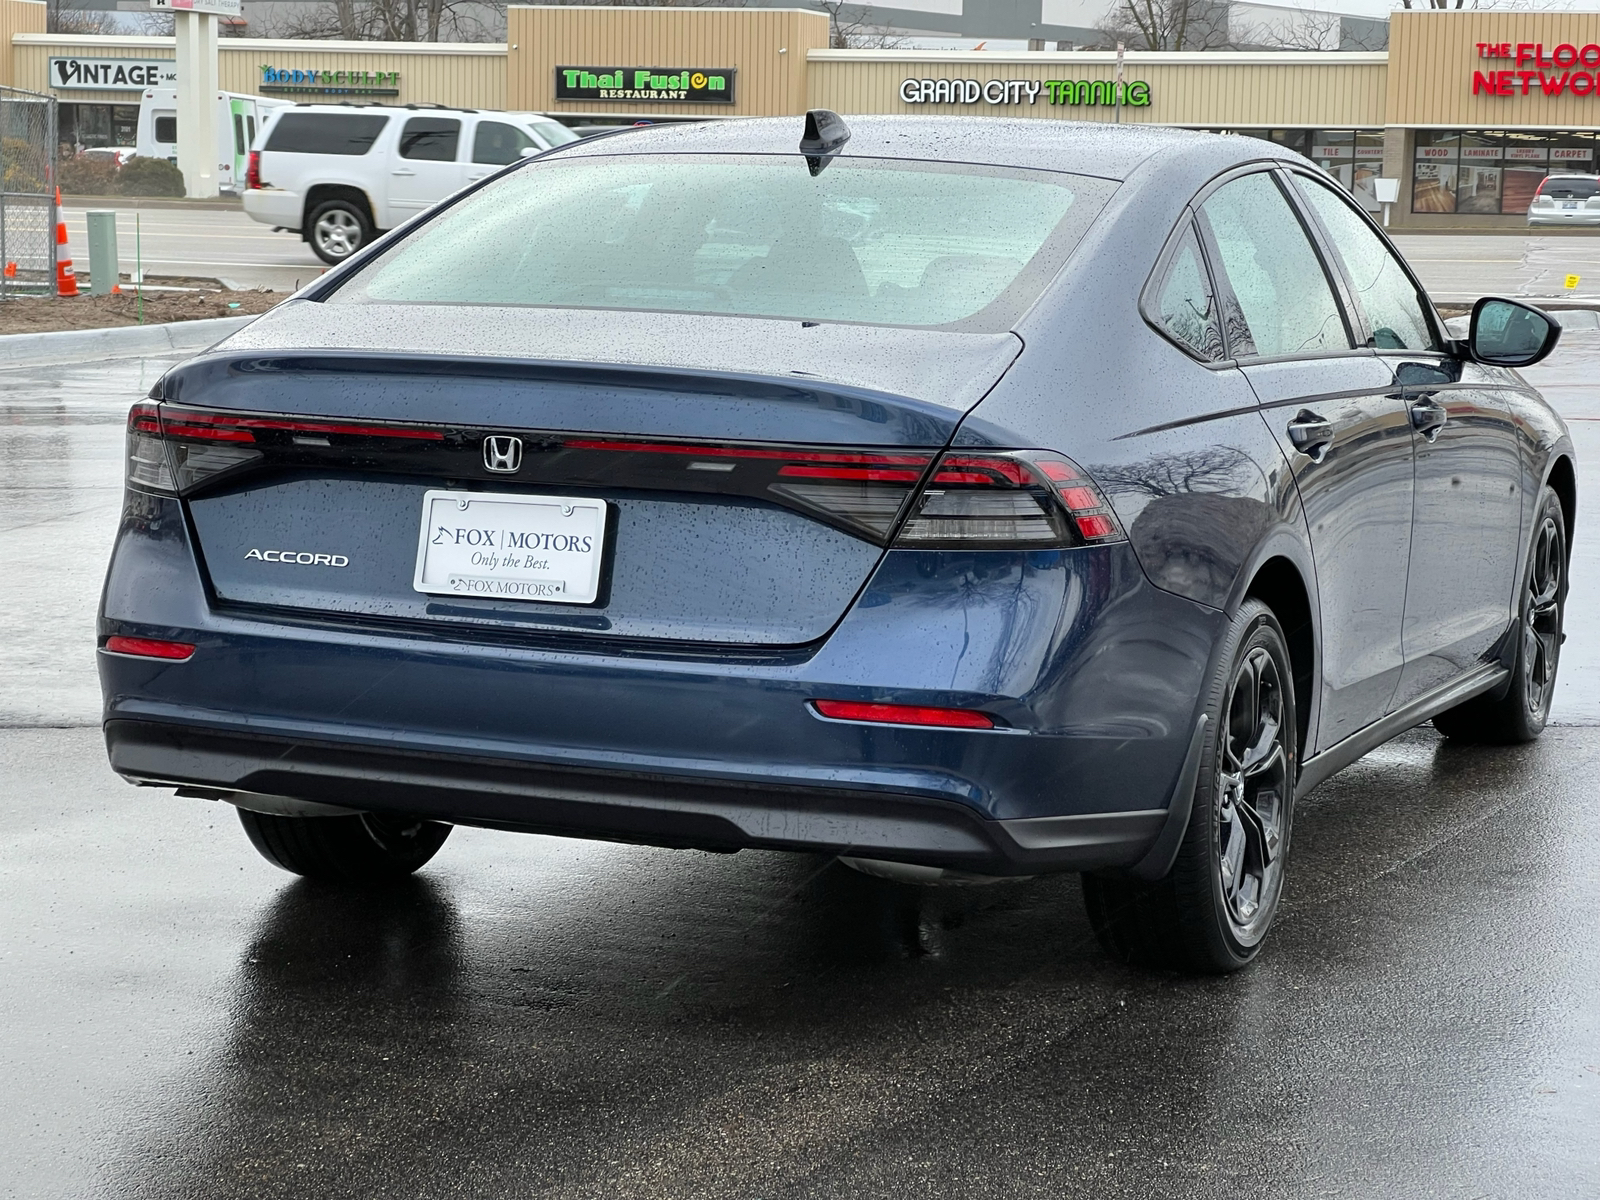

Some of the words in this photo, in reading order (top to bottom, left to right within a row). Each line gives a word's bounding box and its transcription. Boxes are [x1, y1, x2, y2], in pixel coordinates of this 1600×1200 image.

[218, 0, 239, 8] THERAPY
[1476, 43, 1511, 58] THE
[1516, 43, 1600, 68] FLOO
[54, 60, 158, 85] VINTAGE
[563, 70, 623, 88] Thai
[634, 71, 725, 90] Fusion
[900, 79, 980, 104] GRAND
[983, 80, 1041, 105] CITY
[1044, 80, 1150, 106] TANNING
[1473, 71, 1600, 96] NETWO
[600, 90, 687, 99] RESTAURANT
[1323, 148, 1339, 156] TILE
[1424, 148, 1449, 157] WOOD
[1463, 149, 1499, 157] LAMINATE
[1554, 150, 1587, 158] CARPET
[454, 528, 495, 546] FOX
[508, 531, 592, 553] MOTORS
[244, 548, 349, 567] ACCORD
[471, 551, 500, 570] Only
[502, 553, 520, 568] the
[524, 555, 550, 570] Best.
[467, 579, 493, 593] FOX
[496, 581, 554, 596] MOTORS
